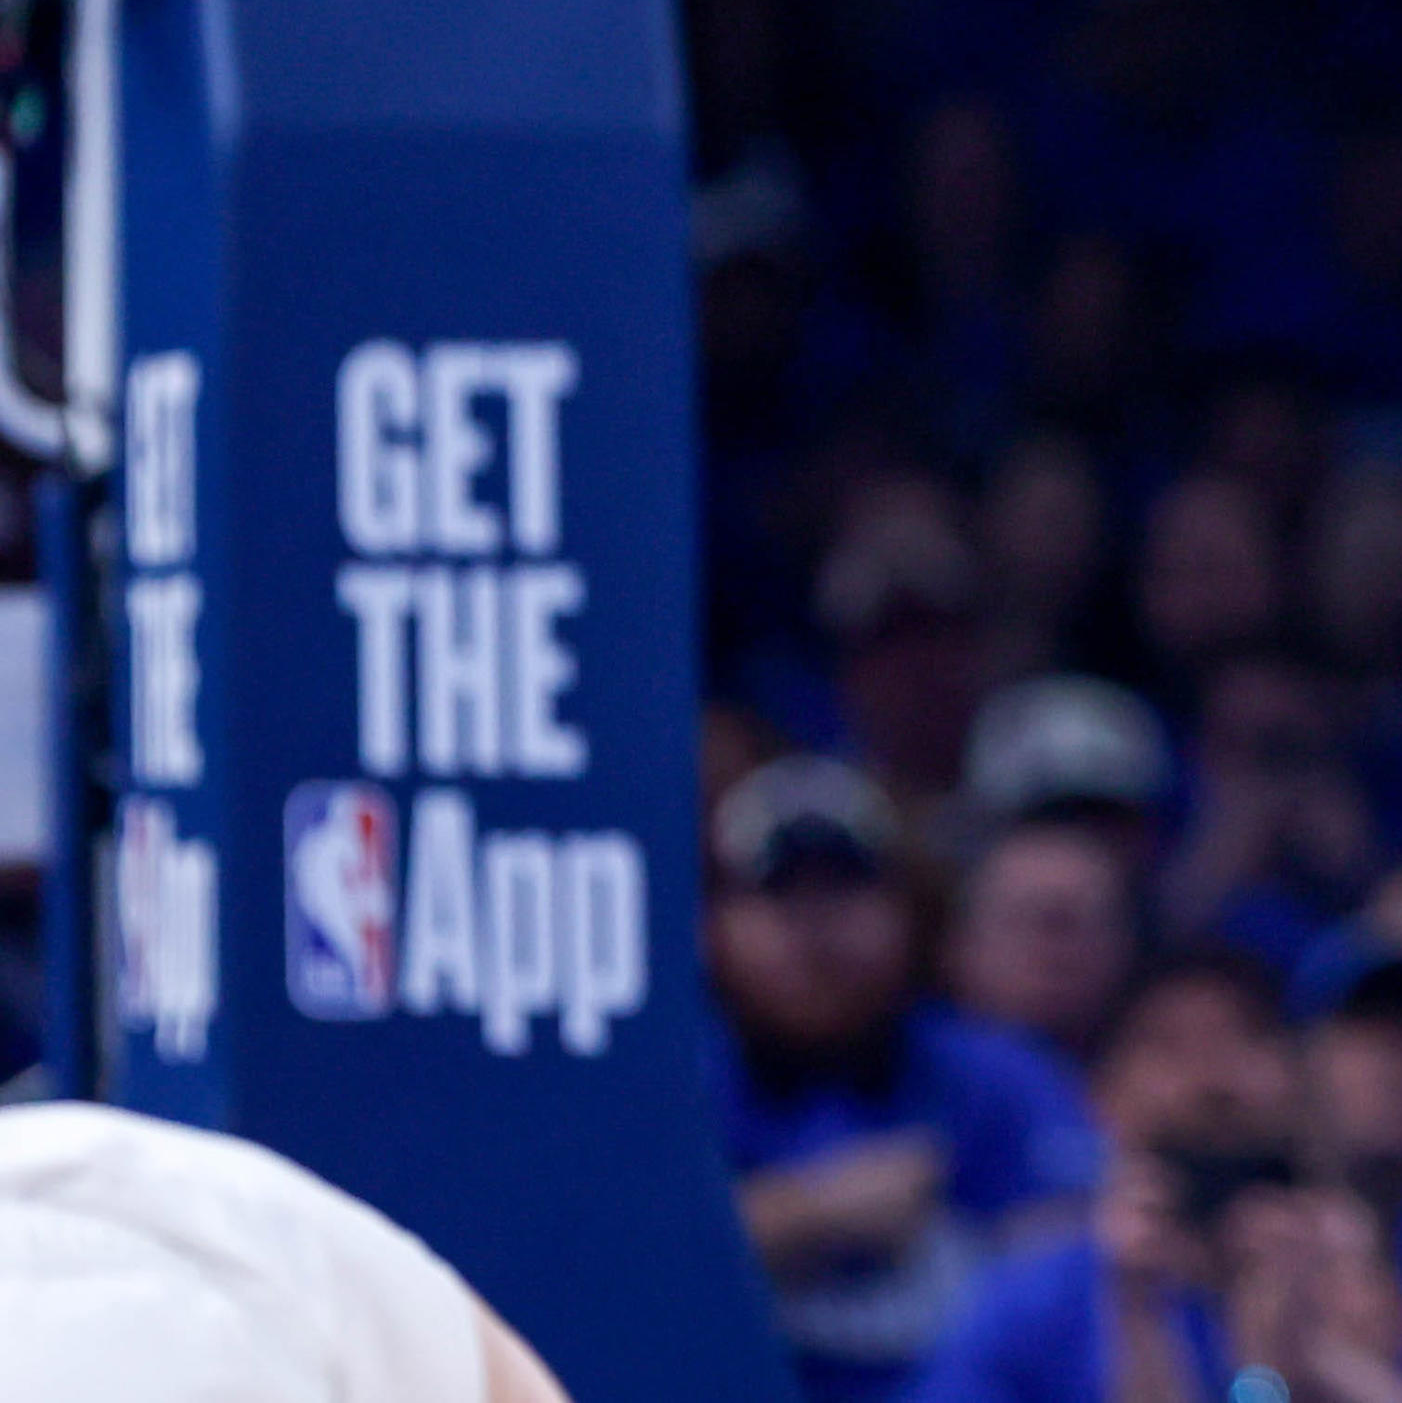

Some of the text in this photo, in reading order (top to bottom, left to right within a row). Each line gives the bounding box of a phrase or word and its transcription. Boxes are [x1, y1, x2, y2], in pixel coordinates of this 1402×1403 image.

[338, 344, 575, 553] GET
[337, 565, 584, 775] THE
[402, 792, 645, 1053] App
